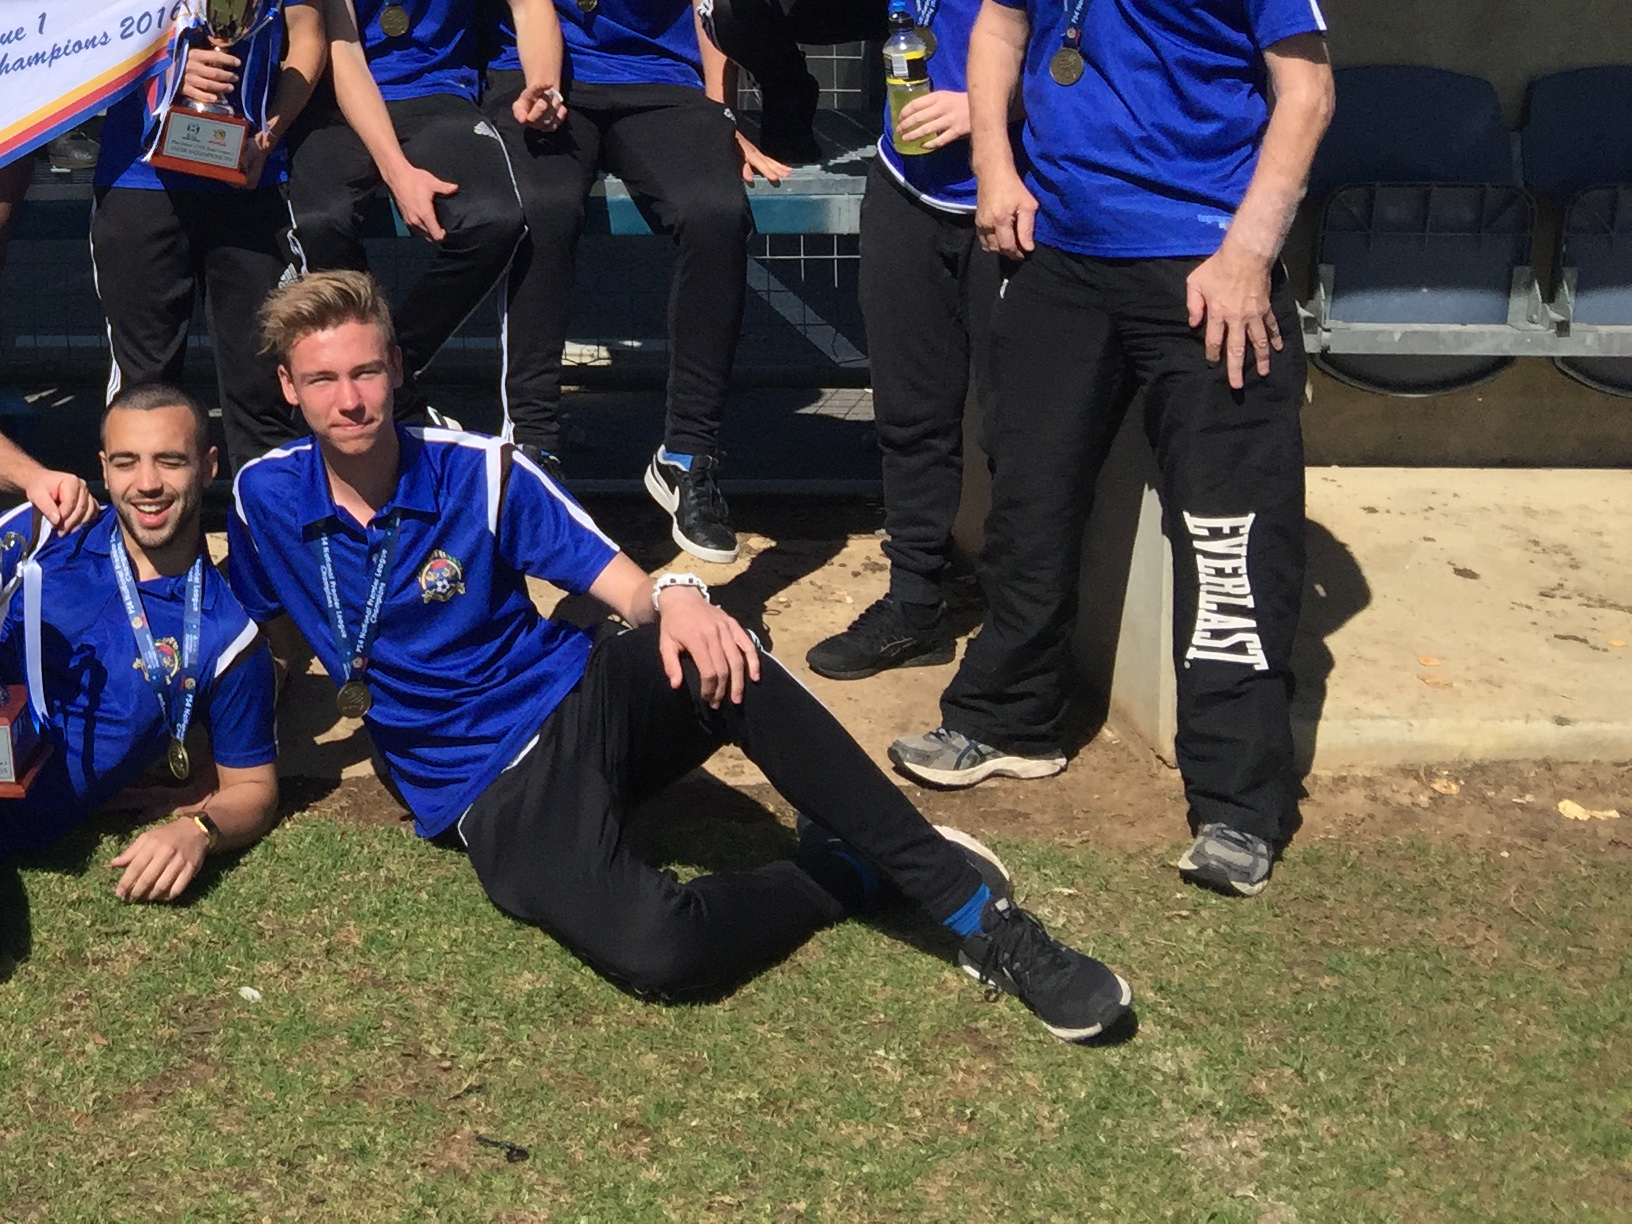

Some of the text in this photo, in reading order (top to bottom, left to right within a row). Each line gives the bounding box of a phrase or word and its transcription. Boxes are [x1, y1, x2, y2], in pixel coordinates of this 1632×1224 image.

[36, 11, 48, 36] 1
[374, 548, 389, 577] League
[115, 569, 131, 601] National
[191, 584, 199, 611] League
[322, 546, 336, 579] National
[329, 580, 341, 607] Premier
[335, 609, 347, 638] League
[365, 577, 380, 606] Premier
[1182, 511, 1270, 671] EVERLAST
[124, 600, 135, 614] PS4
[368, 582, 388, 624] Champions
[357, 607, 374, 639] National
[183, 693, 193, 707] PS4
